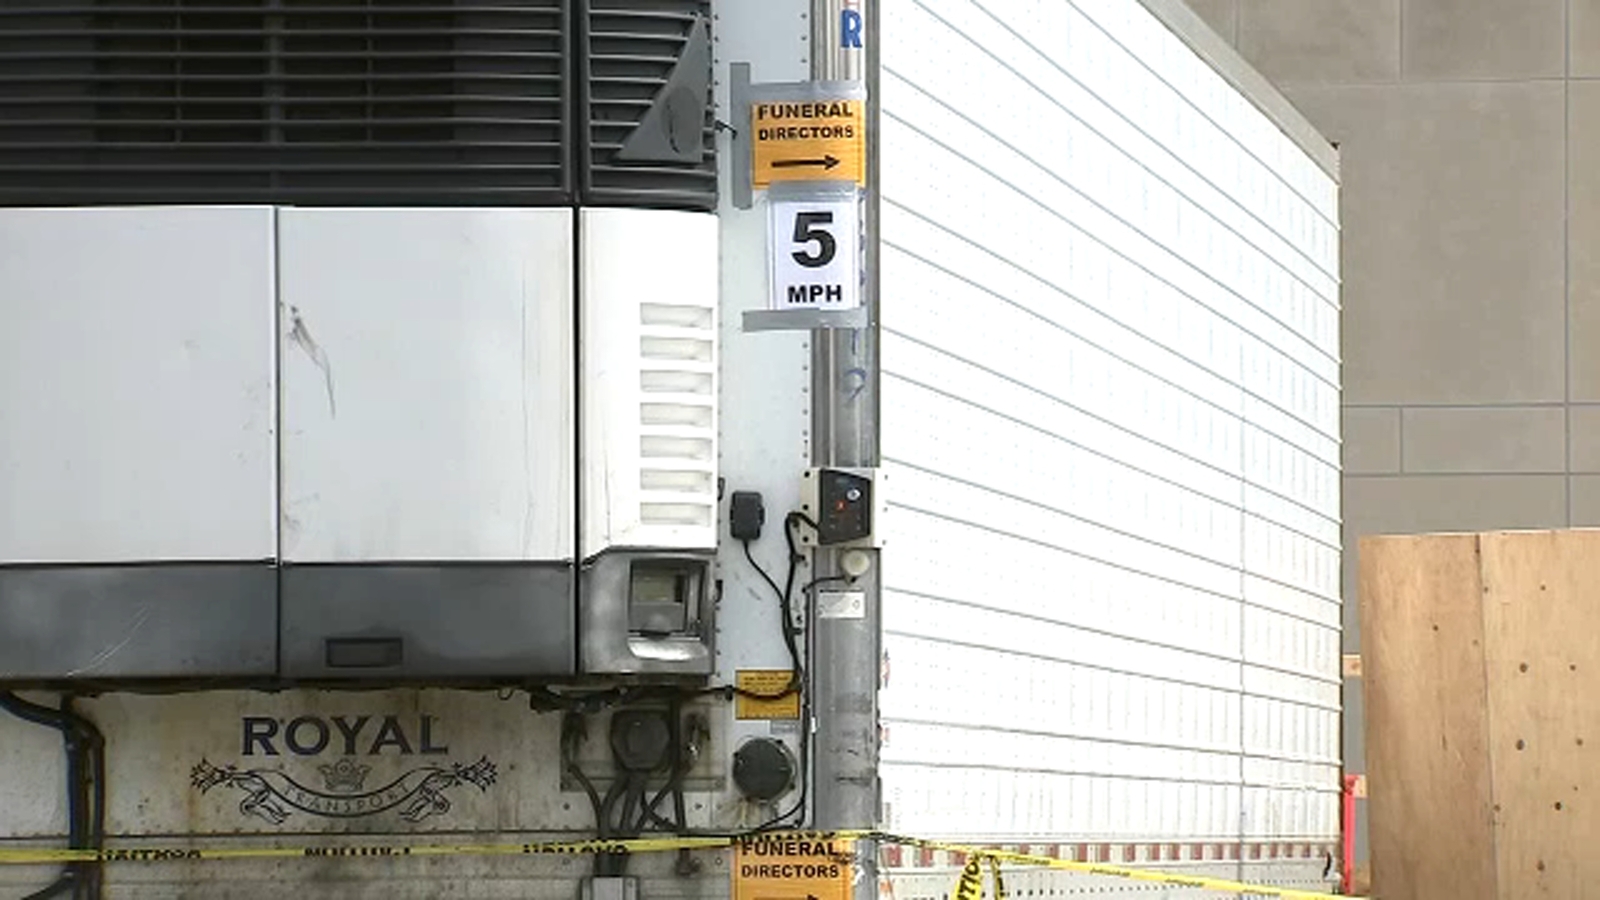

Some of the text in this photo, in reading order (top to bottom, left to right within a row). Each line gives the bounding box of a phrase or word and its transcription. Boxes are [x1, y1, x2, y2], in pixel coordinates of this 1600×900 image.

[757, 102, 854, 121] FUNERAL
[758, 126, 855, 141] DIRECTORS
[791, 211, 837, 268] 5
[787, 284, 842, 303] MPH
[241, 715, 450, 756] ROYAL
[283, 781, 410, 815] TRANSPORT
[742, 841, 839, 856] FUNERAL
[741, 864, 840, 878] DIRECTORS
